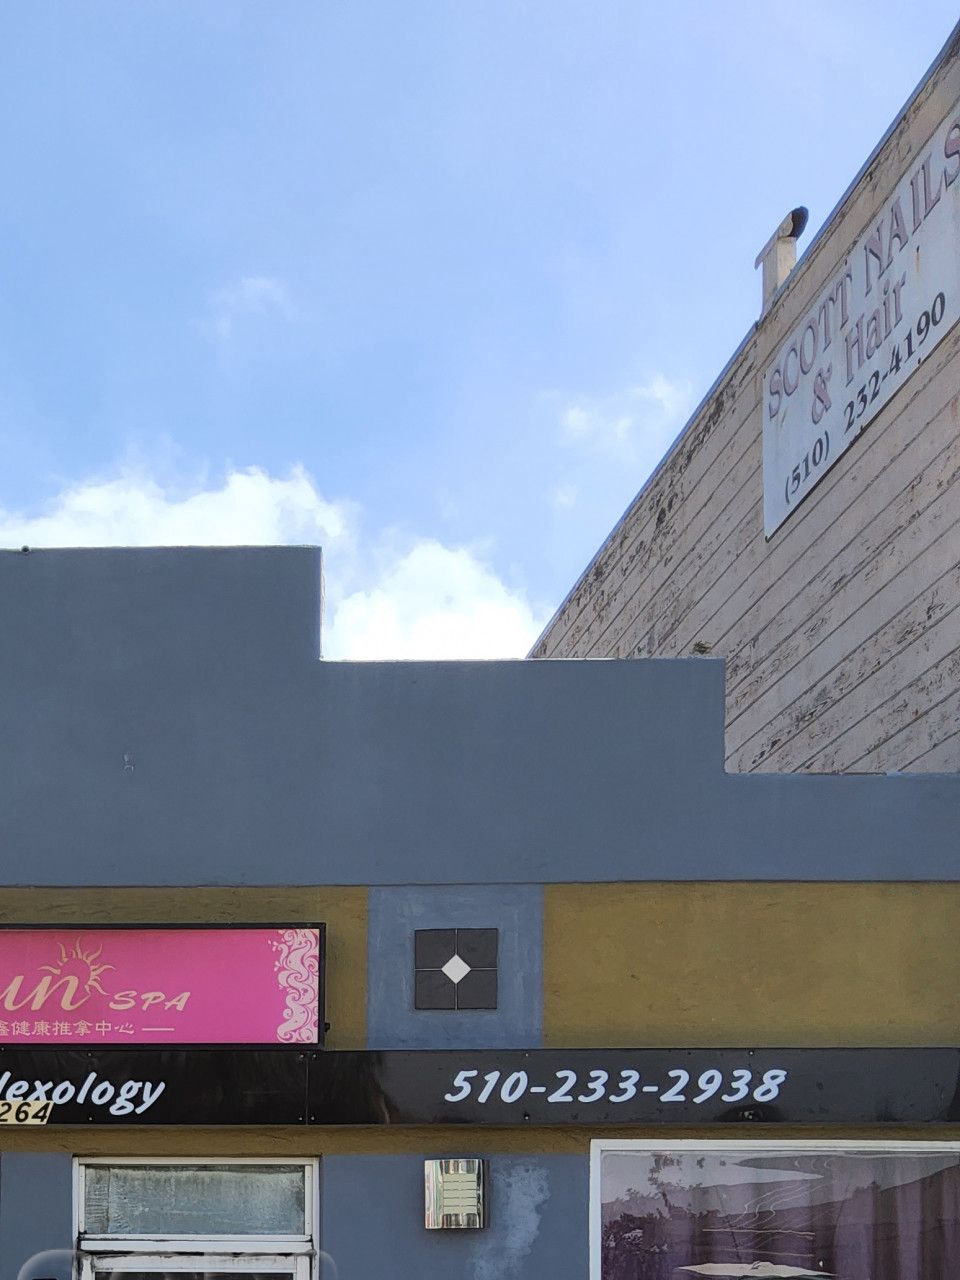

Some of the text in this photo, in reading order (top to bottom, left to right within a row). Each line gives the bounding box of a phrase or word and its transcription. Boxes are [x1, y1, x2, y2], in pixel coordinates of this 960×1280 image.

[769, 265, 853, 419] SCOTT
[785, 291, 946, 505] (510) 232-4190
[812, 271, 907, 425] & Hair
[109, 991, 191, 1011] SPA
[444, 1069, 788, 1104] 510-233-2938
